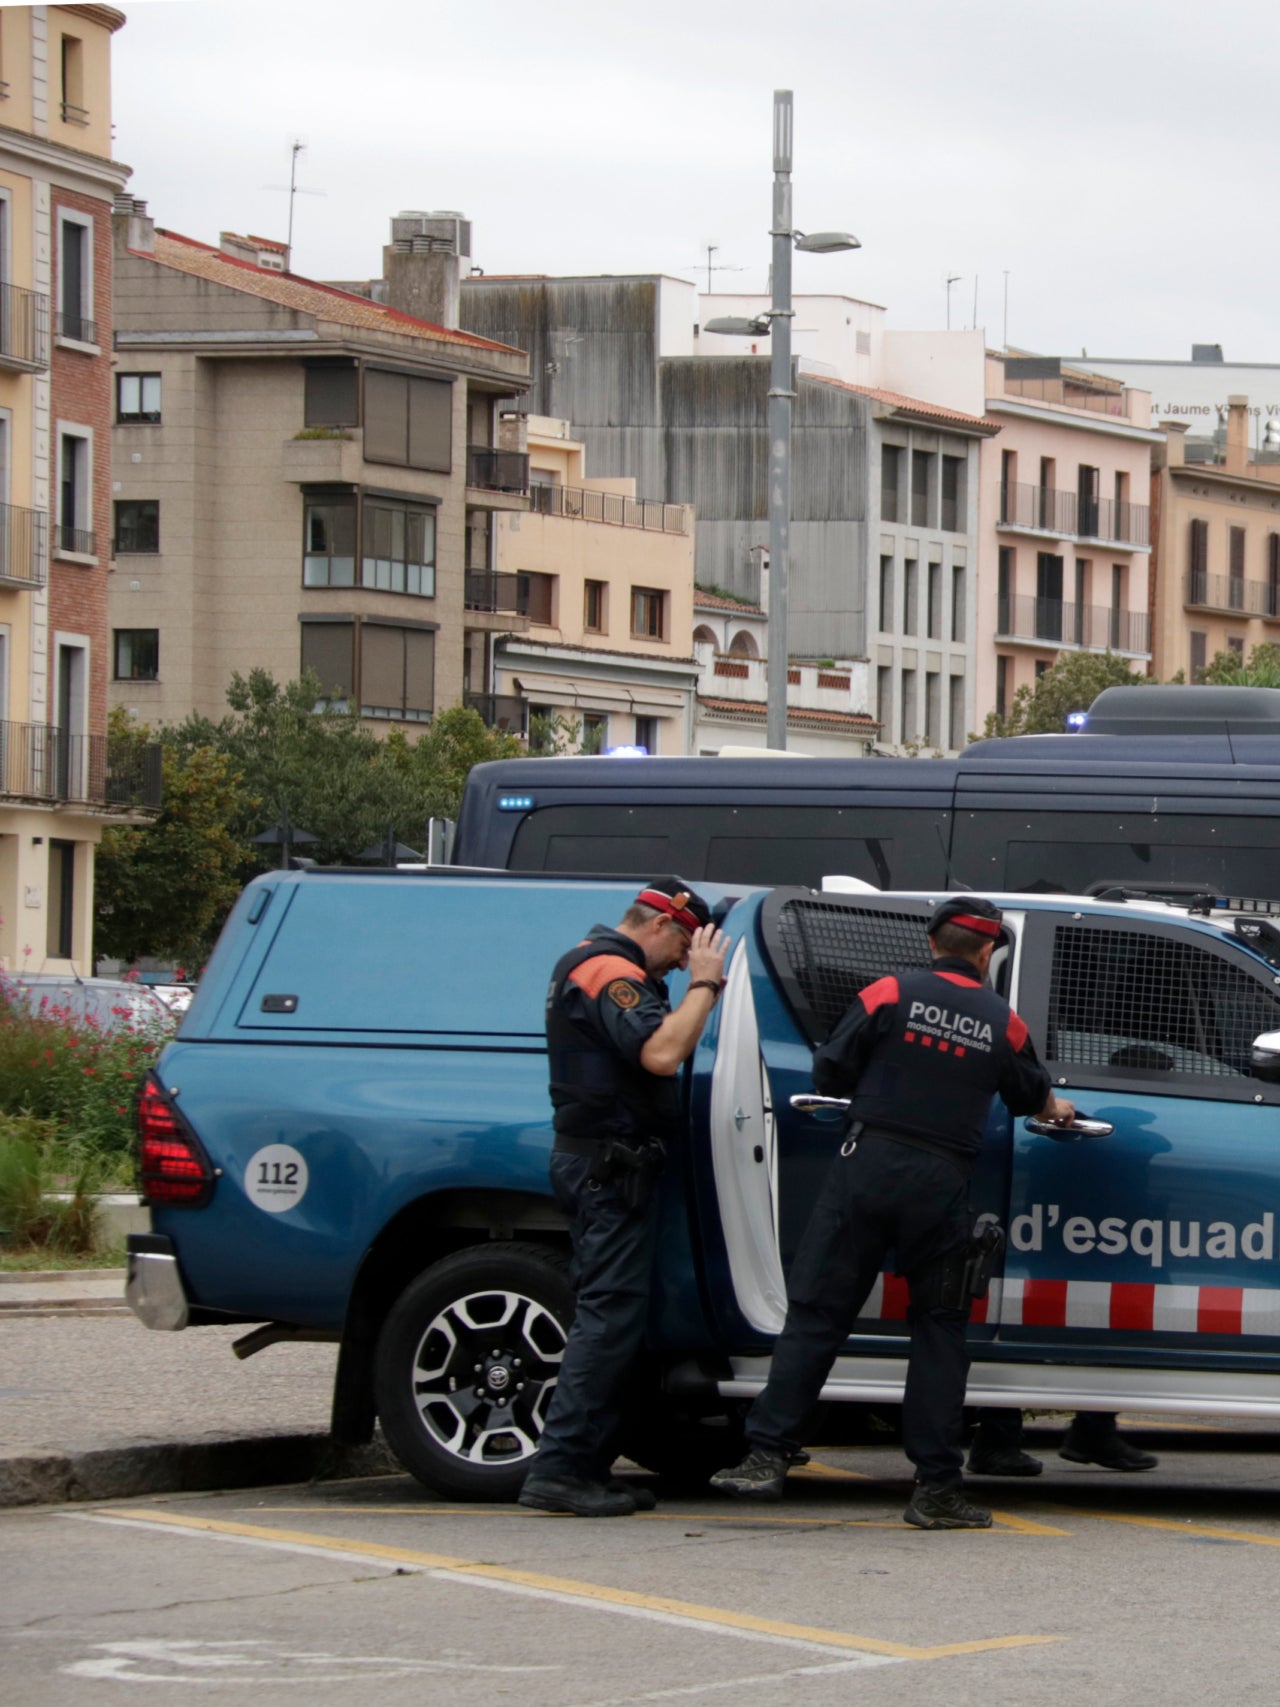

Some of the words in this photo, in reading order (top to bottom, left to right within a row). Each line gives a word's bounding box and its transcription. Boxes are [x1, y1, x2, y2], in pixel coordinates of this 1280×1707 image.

[1163, 403, 1210, 416] Jaume
[1215, 403, 1261, 417] Vins
[906, 1020, 943, 1037] mossos
[909, 1001, 993, 1043] POLICIA
[258, 1161, 298, 1185] 112
